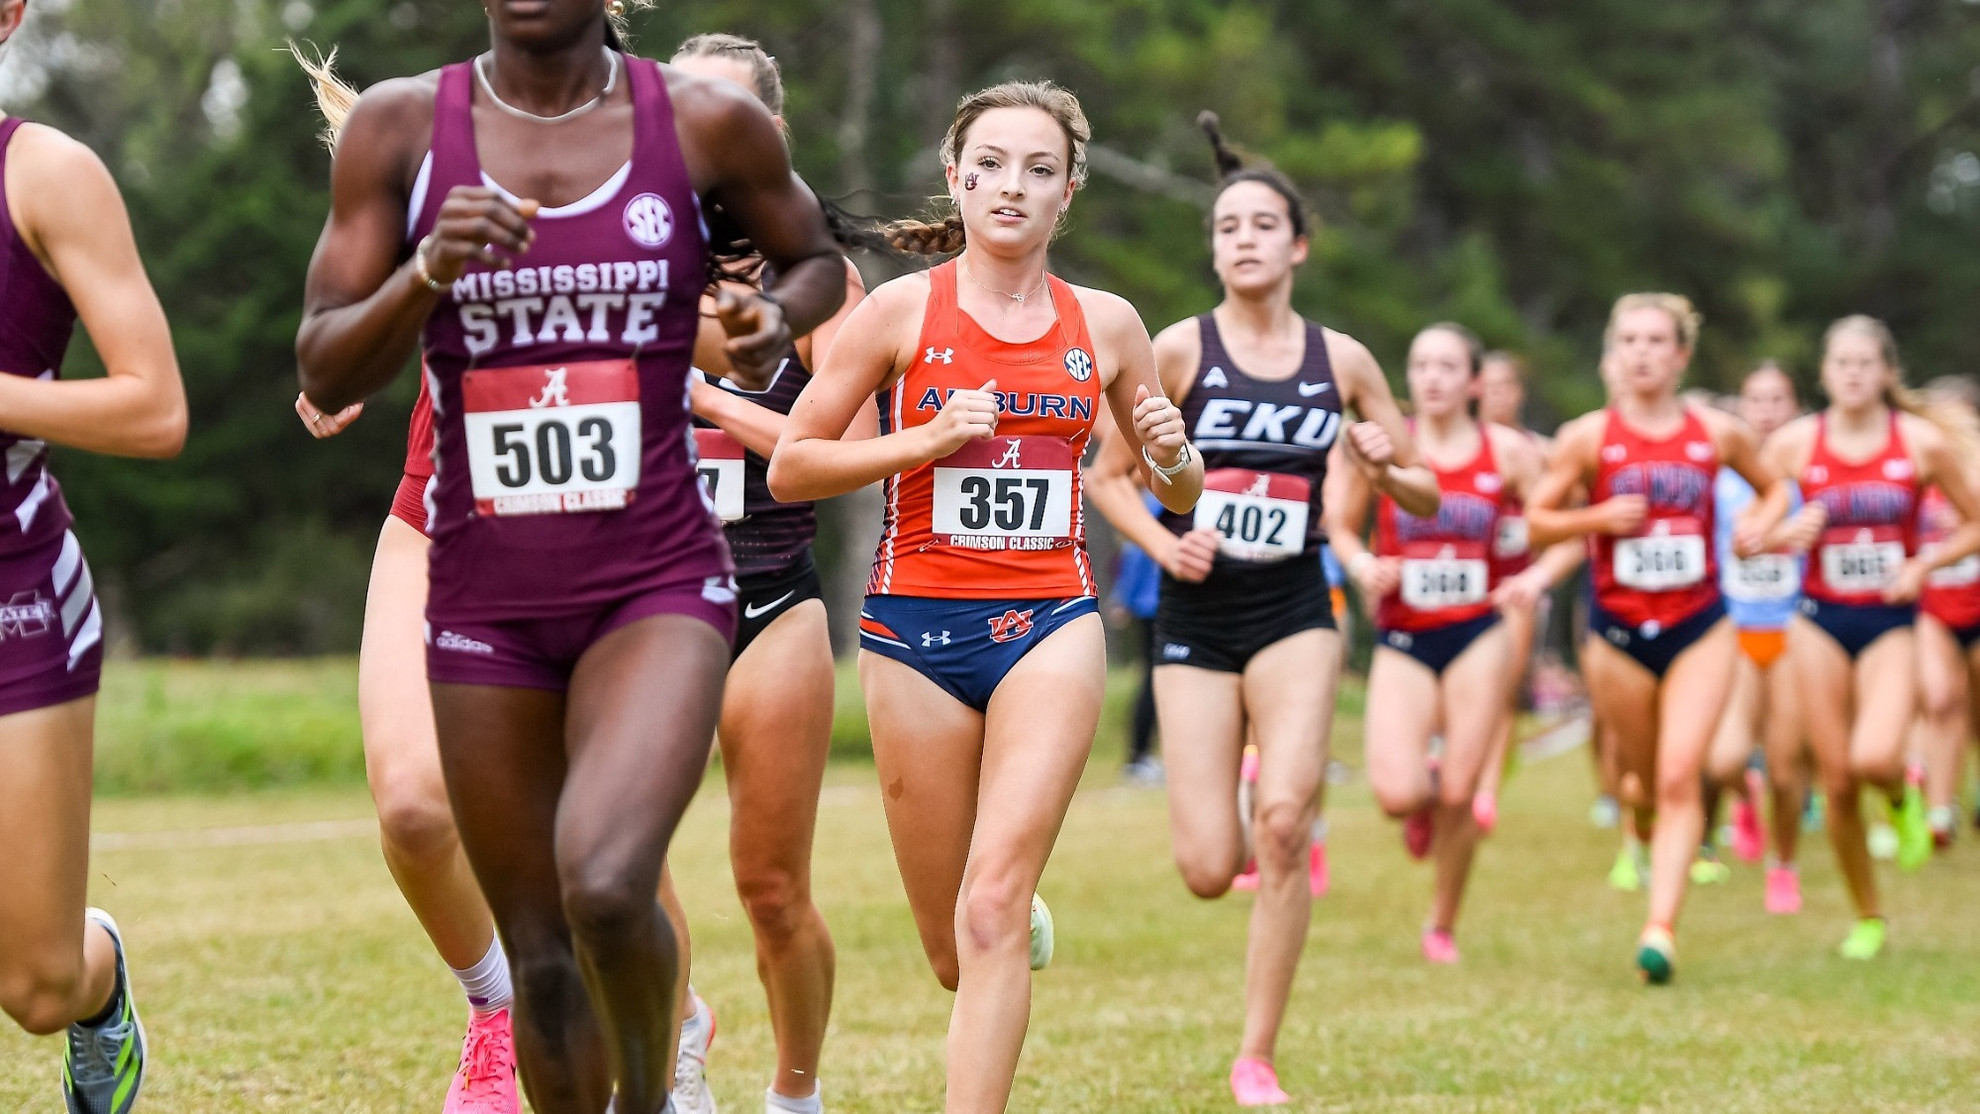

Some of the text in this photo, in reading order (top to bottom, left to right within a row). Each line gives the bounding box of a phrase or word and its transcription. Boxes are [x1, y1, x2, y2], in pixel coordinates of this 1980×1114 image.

[626, 196, 671, 244] SEC
[452, 259, 669, 301] MISSISSIPPI
[459, 292, 666, 356] STATE
[1064, 349, 1092, 382] SEC
[916, 386, 1092, 422] ABURN
[1193, 399, 1341, 450] EKU
[492, 416, 616, 488] 503
[992, 438, 1022, 469] A
[959, 476, 1049, 531] 357
[1216, 503, 1287, 546] 402
[950, 534, 1054, 551] CRIMSON CLASSIC
